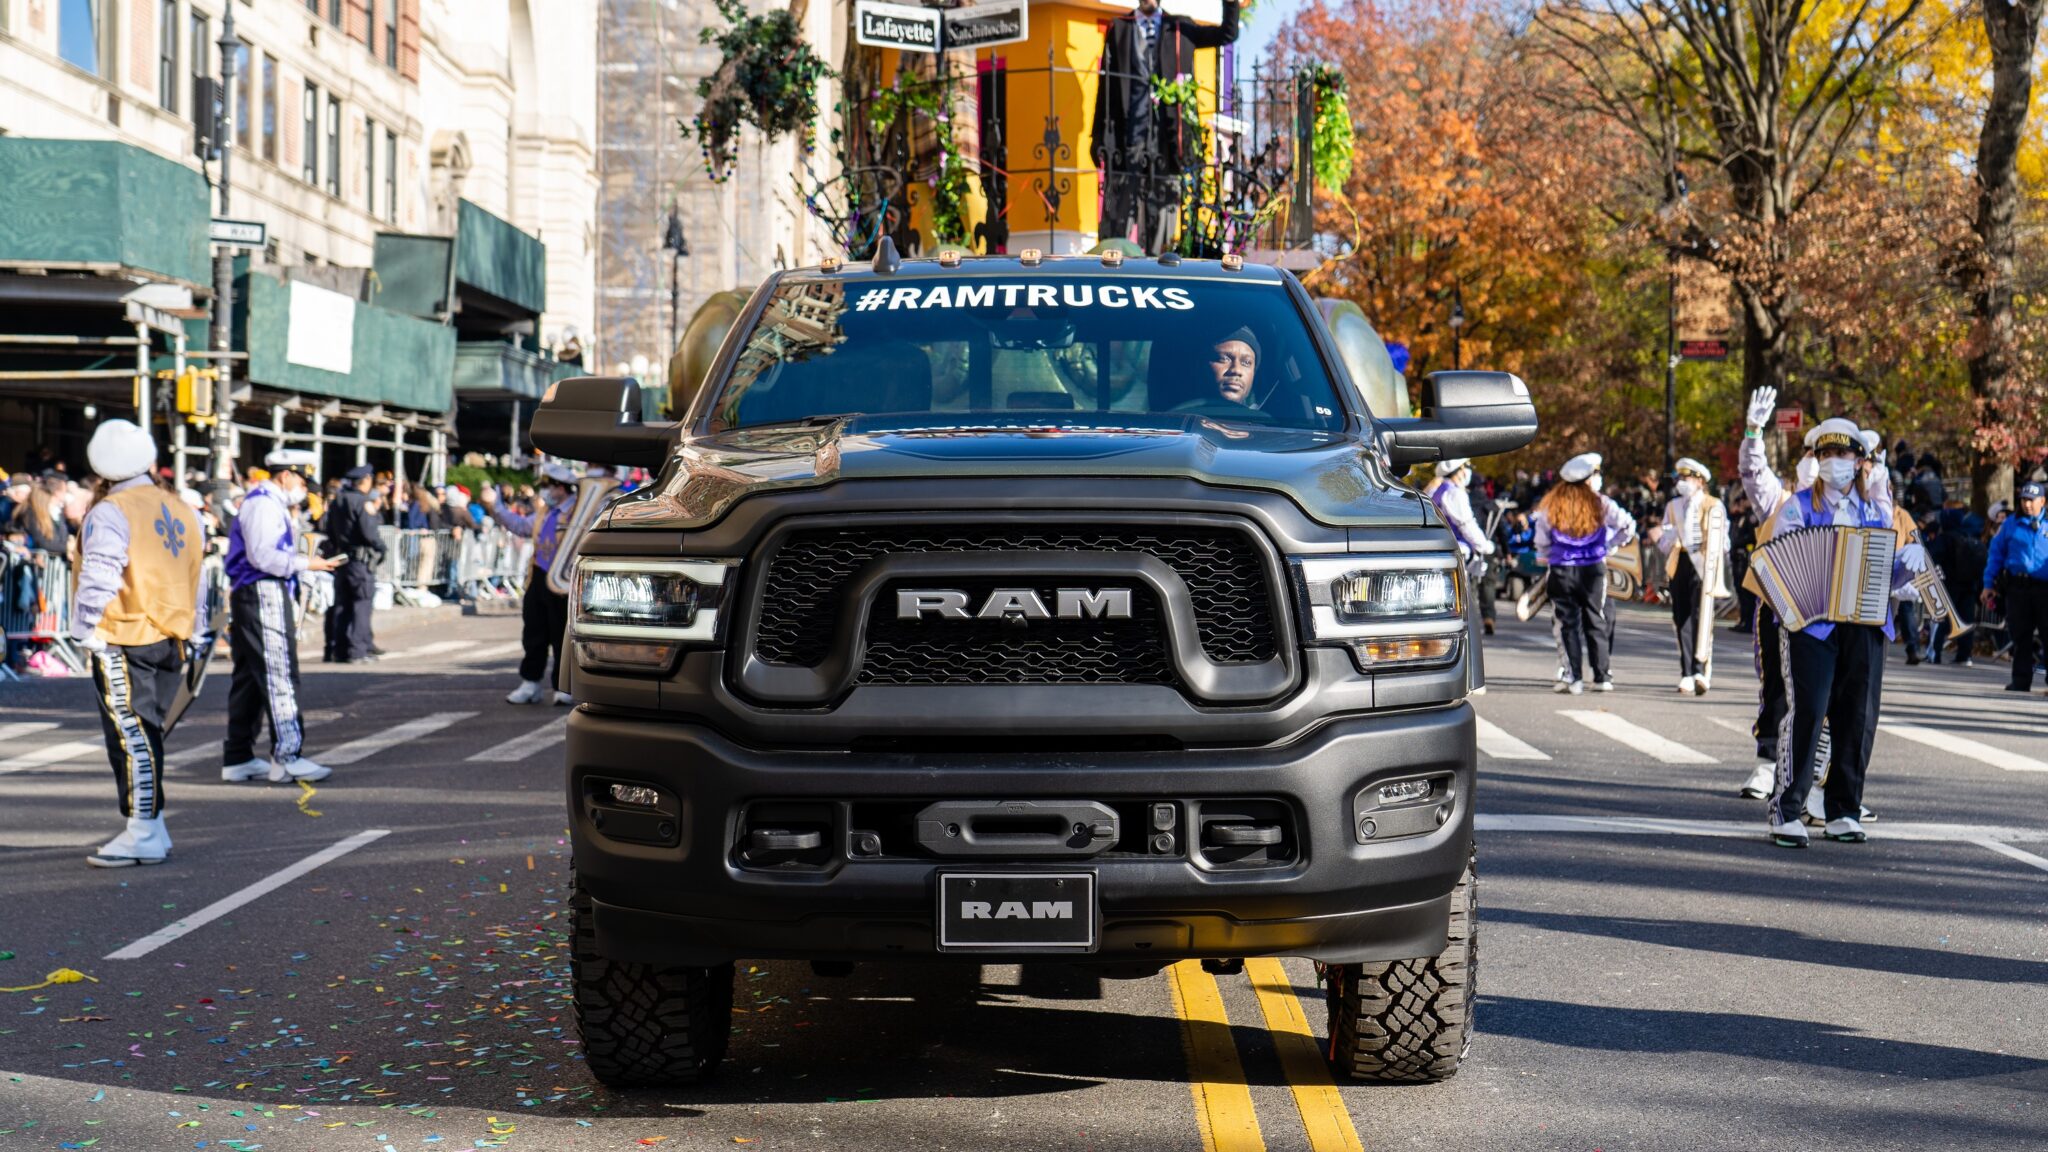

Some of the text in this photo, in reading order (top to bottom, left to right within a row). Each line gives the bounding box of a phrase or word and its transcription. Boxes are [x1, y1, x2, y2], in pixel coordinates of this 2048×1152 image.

[865, 15, 933, 43] Lafayette
[949, 20, 1020, 42] Natchitoches
[855, 285, 1195, 311] #RAMTRUCKS
[896, 587, 1132, 619] RAM
[961, 901, 1073, 919] RAM
